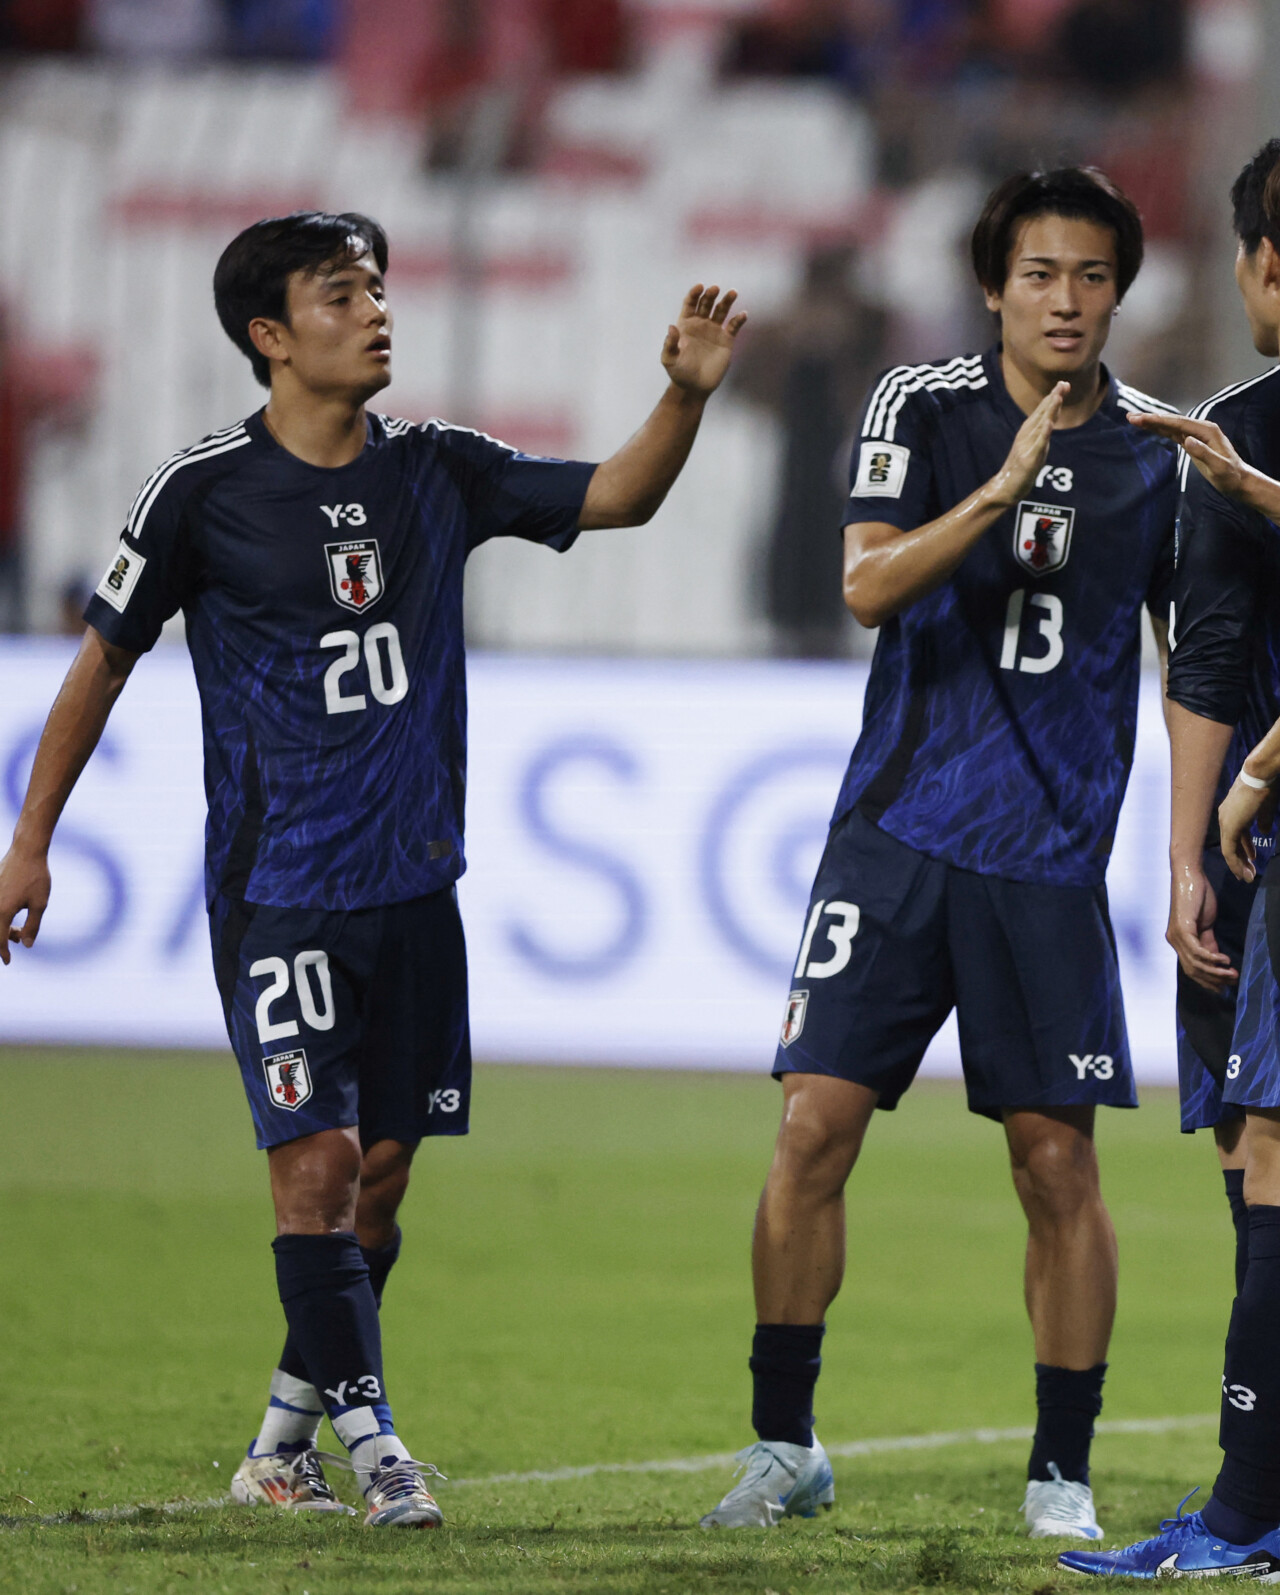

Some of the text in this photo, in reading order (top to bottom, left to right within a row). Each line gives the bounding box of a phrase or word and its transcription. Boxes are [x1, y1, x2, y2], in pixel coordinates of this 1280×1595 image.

[319, 503, 367, 528] Y-3
[338, 543, 365, 552] JAPAN
[1000, 588, 1064, 675] 13
[319, 621, 409, 715] 20
[794, 899, 860, 979] 13
[249, 950, 336, 1044] 20
[272, 1053, 295, 1064] JAPAN
[1068, 1054, 1115, 1081] Y-3
[323, 1375, 381, 1406] Y-3
